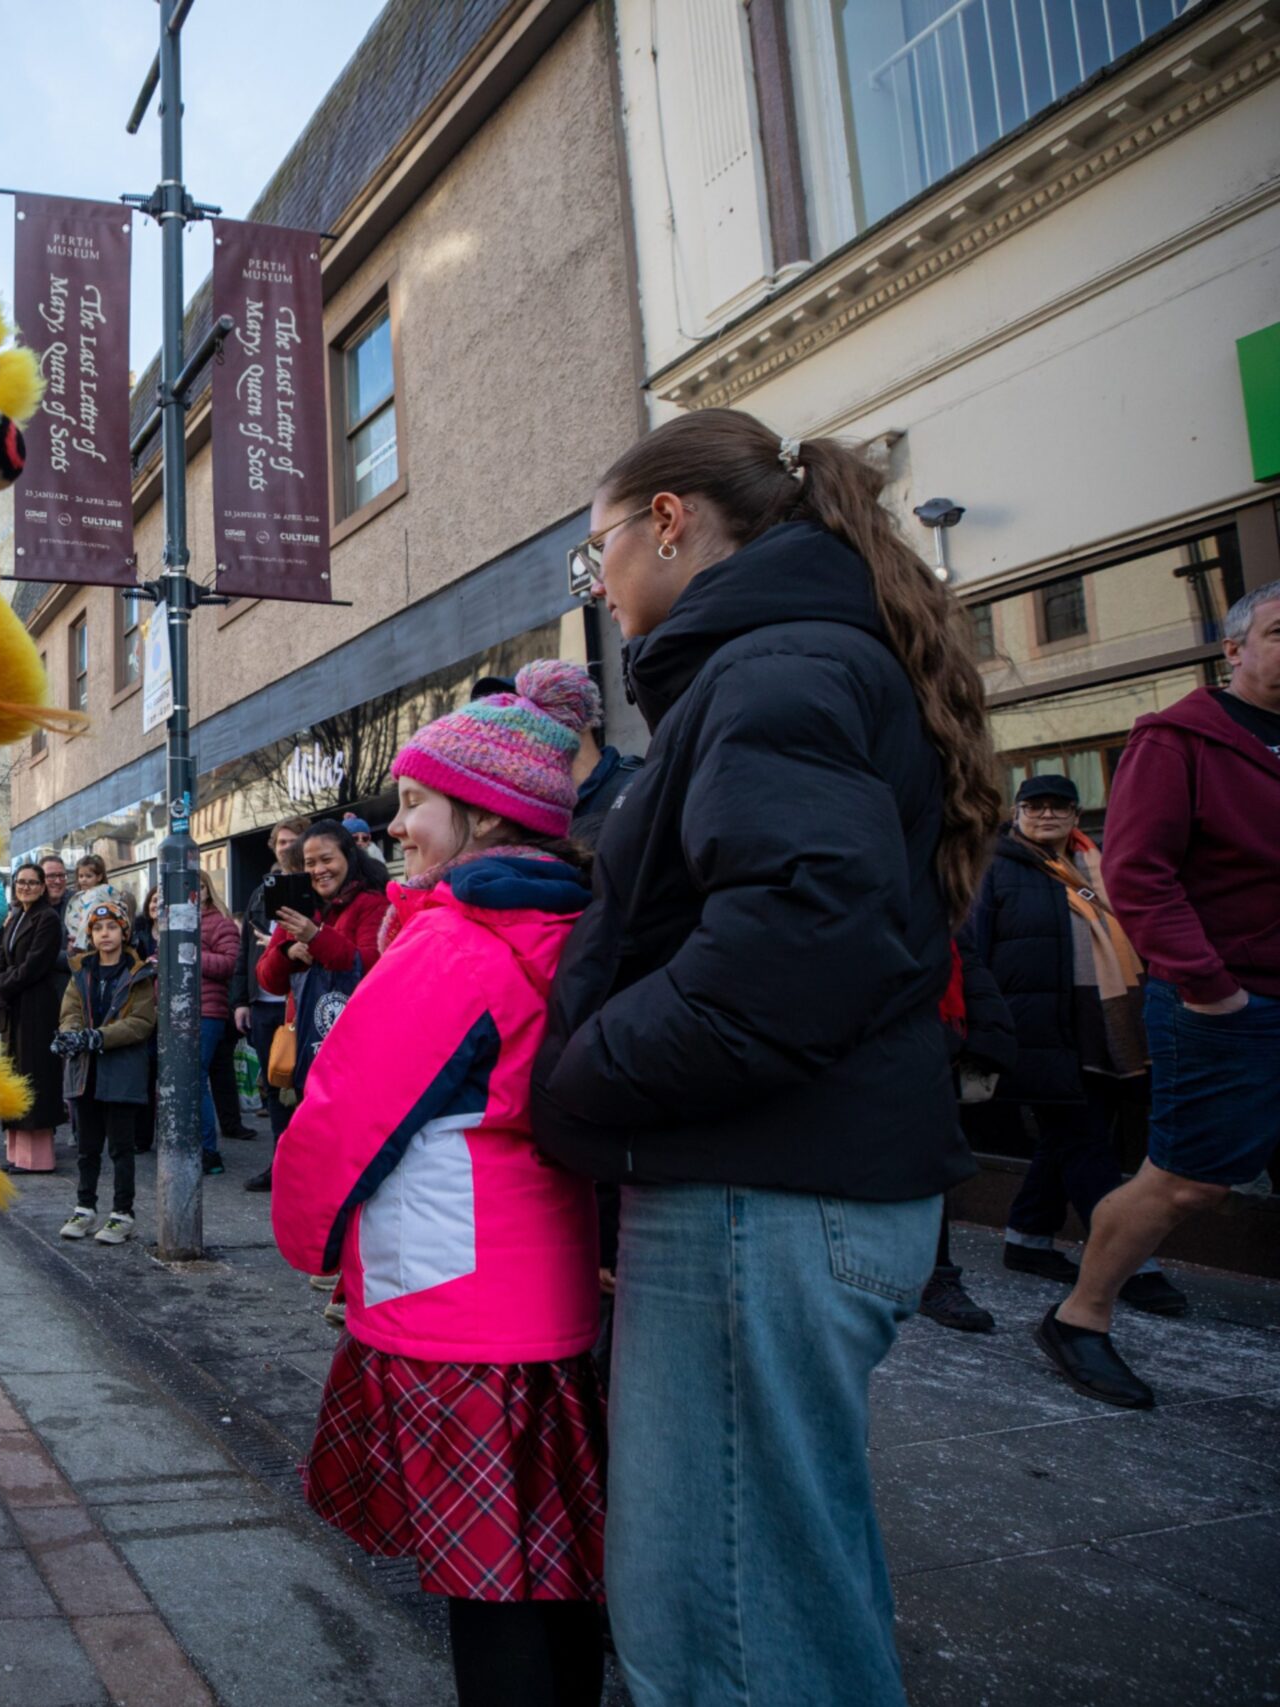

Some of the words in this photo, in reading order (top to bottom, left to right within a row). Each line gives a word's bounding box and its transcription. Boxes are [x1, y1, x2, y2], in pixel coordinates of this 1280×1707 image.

[47, 244, 100, 260] MUSEUM
[53, 233, 93, 248] PERTH
[242, 268, 293, 284] MUSEUM
[248, 258, 286, 272] PERTH
[38, 272, 69, 333] Mary,
[80, 284, 106, 330] The
[235, 296, 264, 356] Mary,
[275, 306, 301, 350] The
[40, 341, 68, 395] Queen
[80, 333, 99, 377] Last
[236, 364, 264, 416] Queen
[276, 353, 296, 396] Last
[42, 399, 77, 425] of
[80, 380, 99, 435] Letter
[238, 422, 274, 445] of
[277, 398, 296, 452] Letter
[49, 424, 70, 473] Scots
[72, 437, 107, 463] of
[247, 445, 268, 492] Scots
[269, 456, 304, 479] of
[33, 490, 69, 501] JANUARY
[84, 497, 104, 506] APRIL
[81, 515, 123, 528] CULTURE
[232, 510, 267, 519] JANUARY
[283, 513, 303, 521] APRIL
[279, 532, 320, 543] CULTURE
